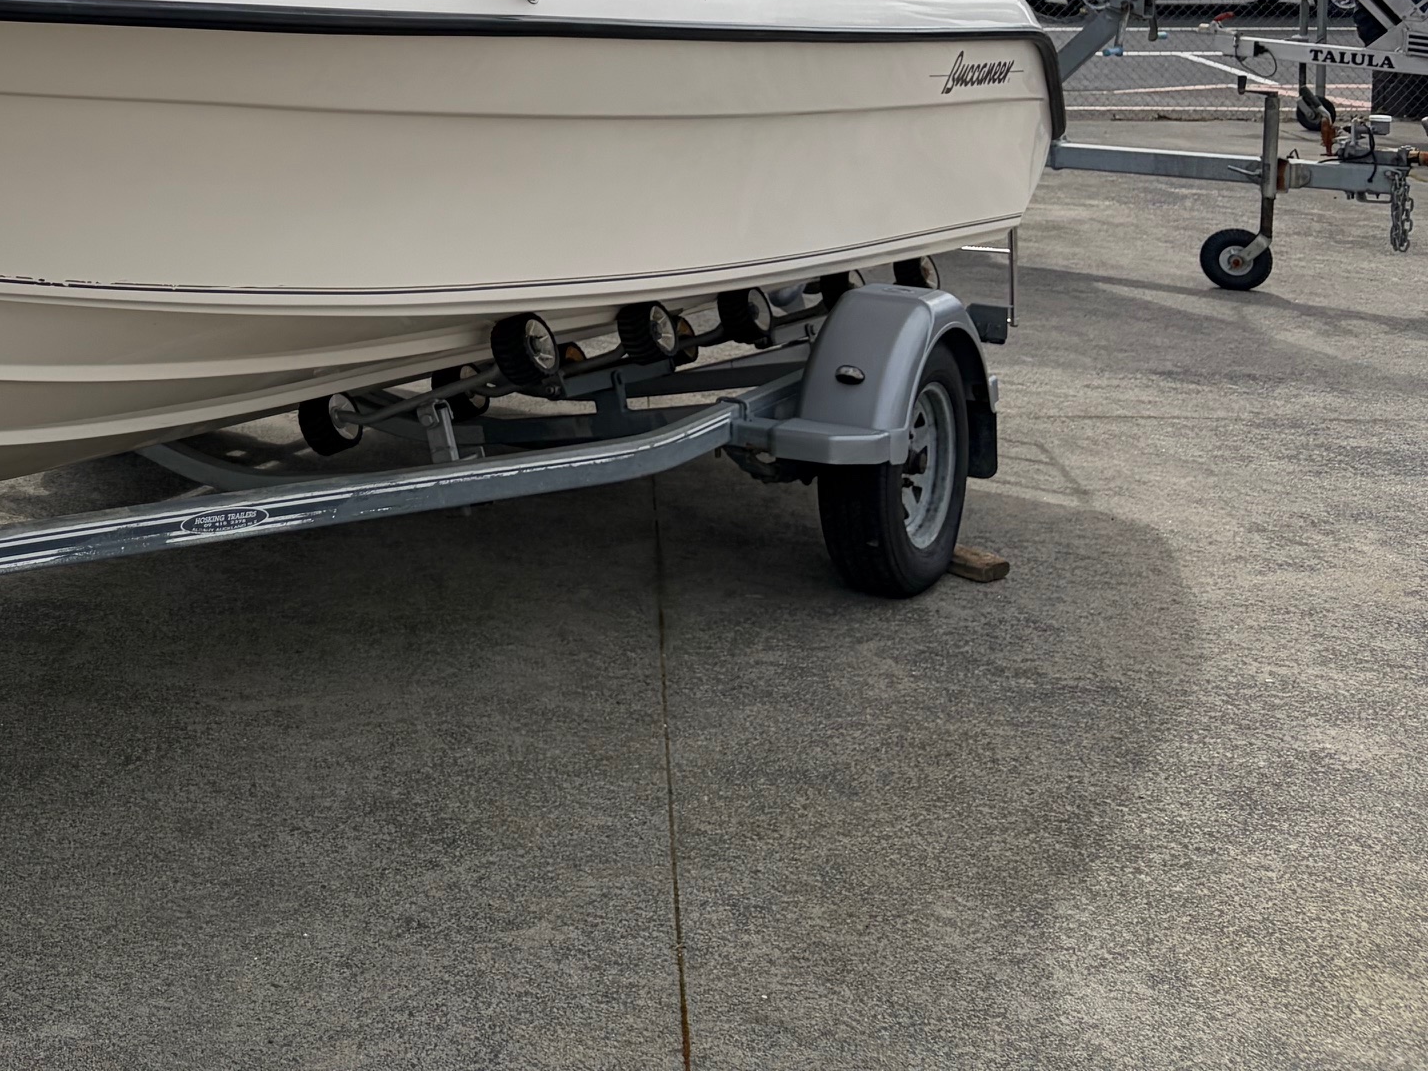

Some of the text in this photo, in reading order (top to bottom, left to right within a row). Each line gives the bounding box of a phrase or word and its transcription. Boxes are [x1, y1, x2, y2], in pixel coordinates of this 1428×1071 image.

[1309, 49, 1395, 69] TALULA
[940, 50, 1015, 95] Buccaneer
[194, 510, 257, 525] HOSKING TRAILERS
